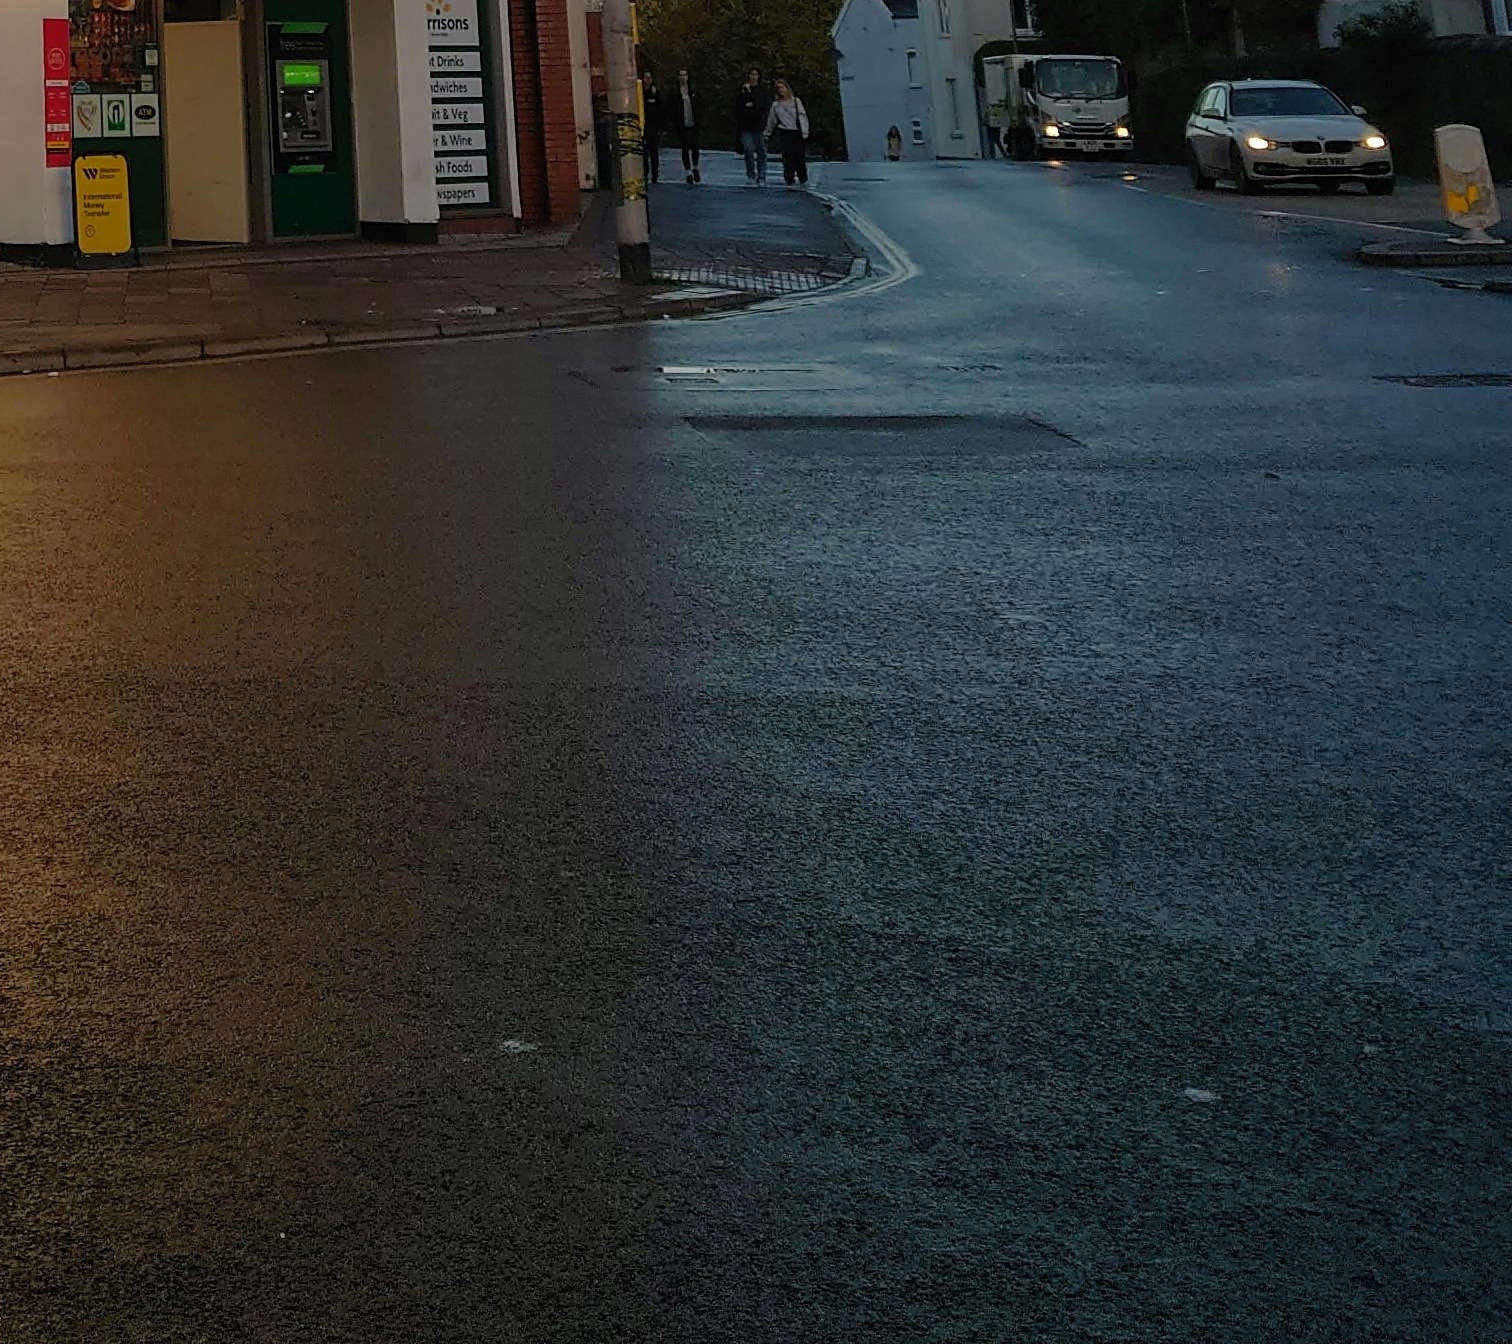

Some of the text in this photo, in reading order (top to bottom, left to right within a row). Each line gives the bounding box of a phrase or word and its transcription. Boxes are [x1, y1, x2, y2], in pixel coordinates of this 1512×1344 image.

[437, 55, 464, 67] Drinks
[443, 108, 448, 119] &
[451, 108, 469, 122] Veg
[441, 134, 447, 146] &
[450, 134, 472, 146] Wine
[447, 160, 473, 173] Foods
